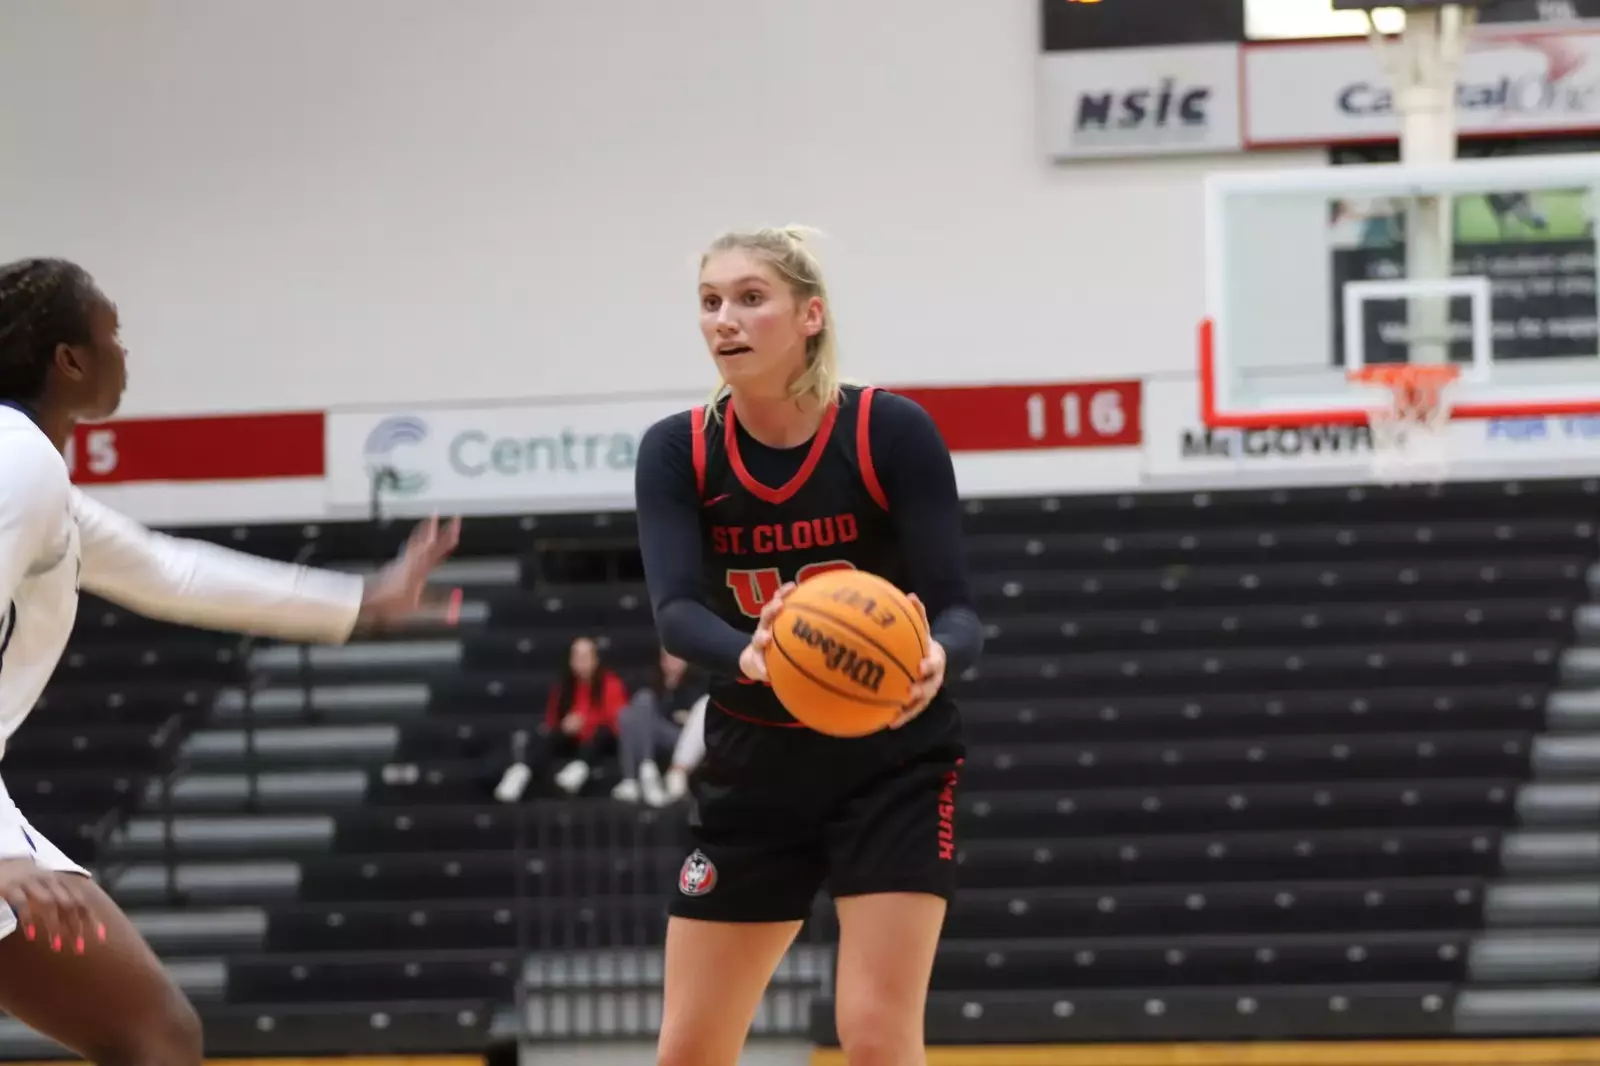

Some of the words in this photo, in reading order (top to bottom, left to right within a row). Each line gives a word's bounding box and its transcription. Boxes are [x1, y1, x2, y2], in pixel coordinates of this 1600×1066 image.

[1026, 389, 1127, 440] 116
[712, 526, 747, 555] ST.
[753, 513, 858, 553] CLOUD
[792, 616, 886, 695] Wilson
